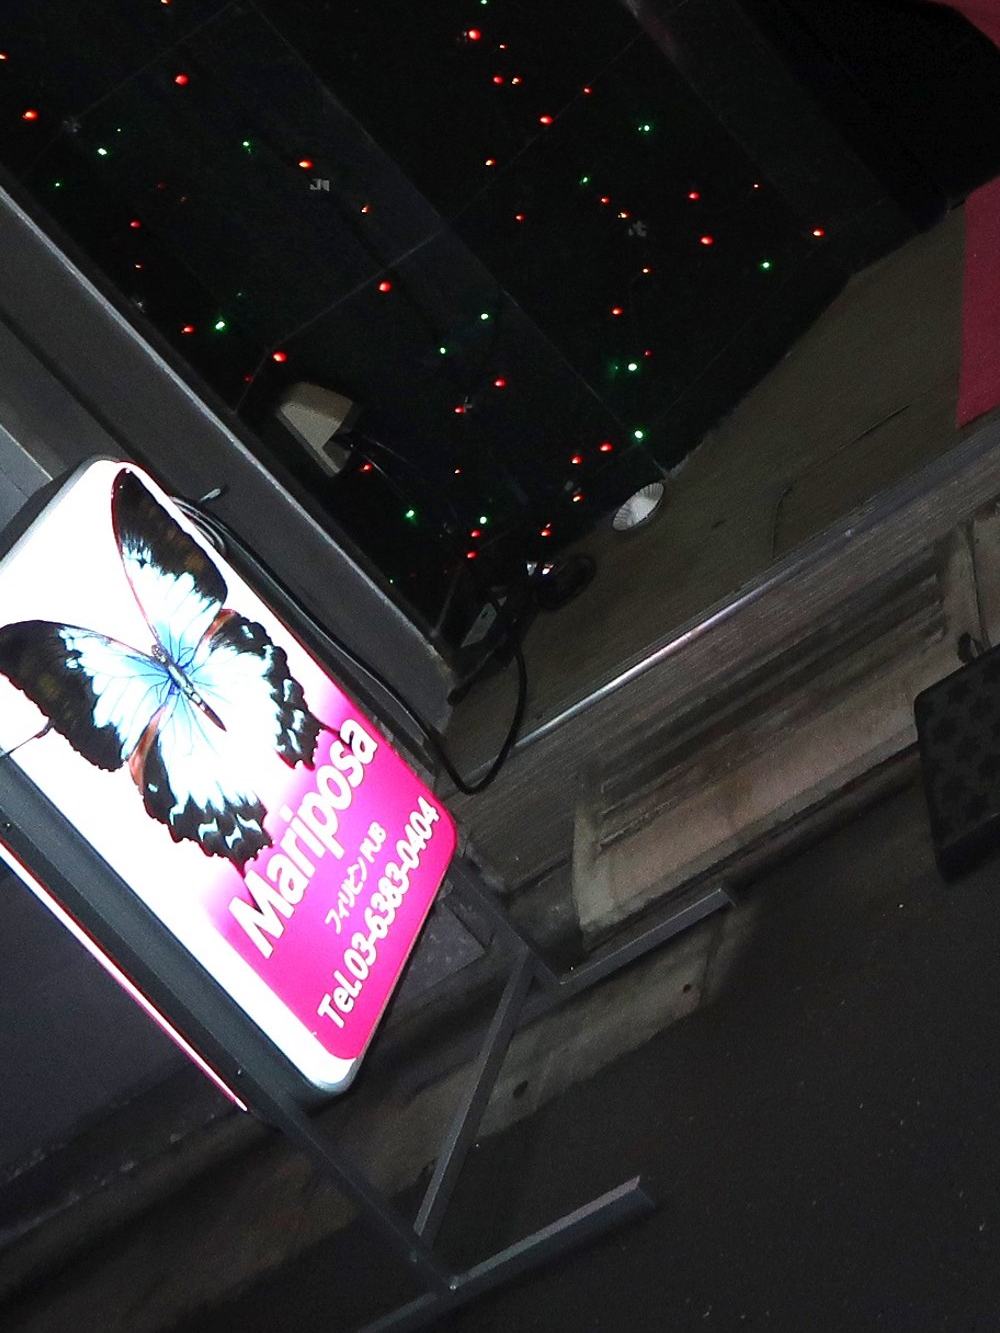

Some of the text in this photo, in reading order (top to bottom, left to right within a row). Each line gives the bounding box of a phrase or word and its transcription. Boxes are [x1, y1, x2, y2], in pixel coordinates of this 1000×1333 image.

[228, 719, 378, 958] Mariposa
[325, 821, 387, 934] フィリピン PUB
